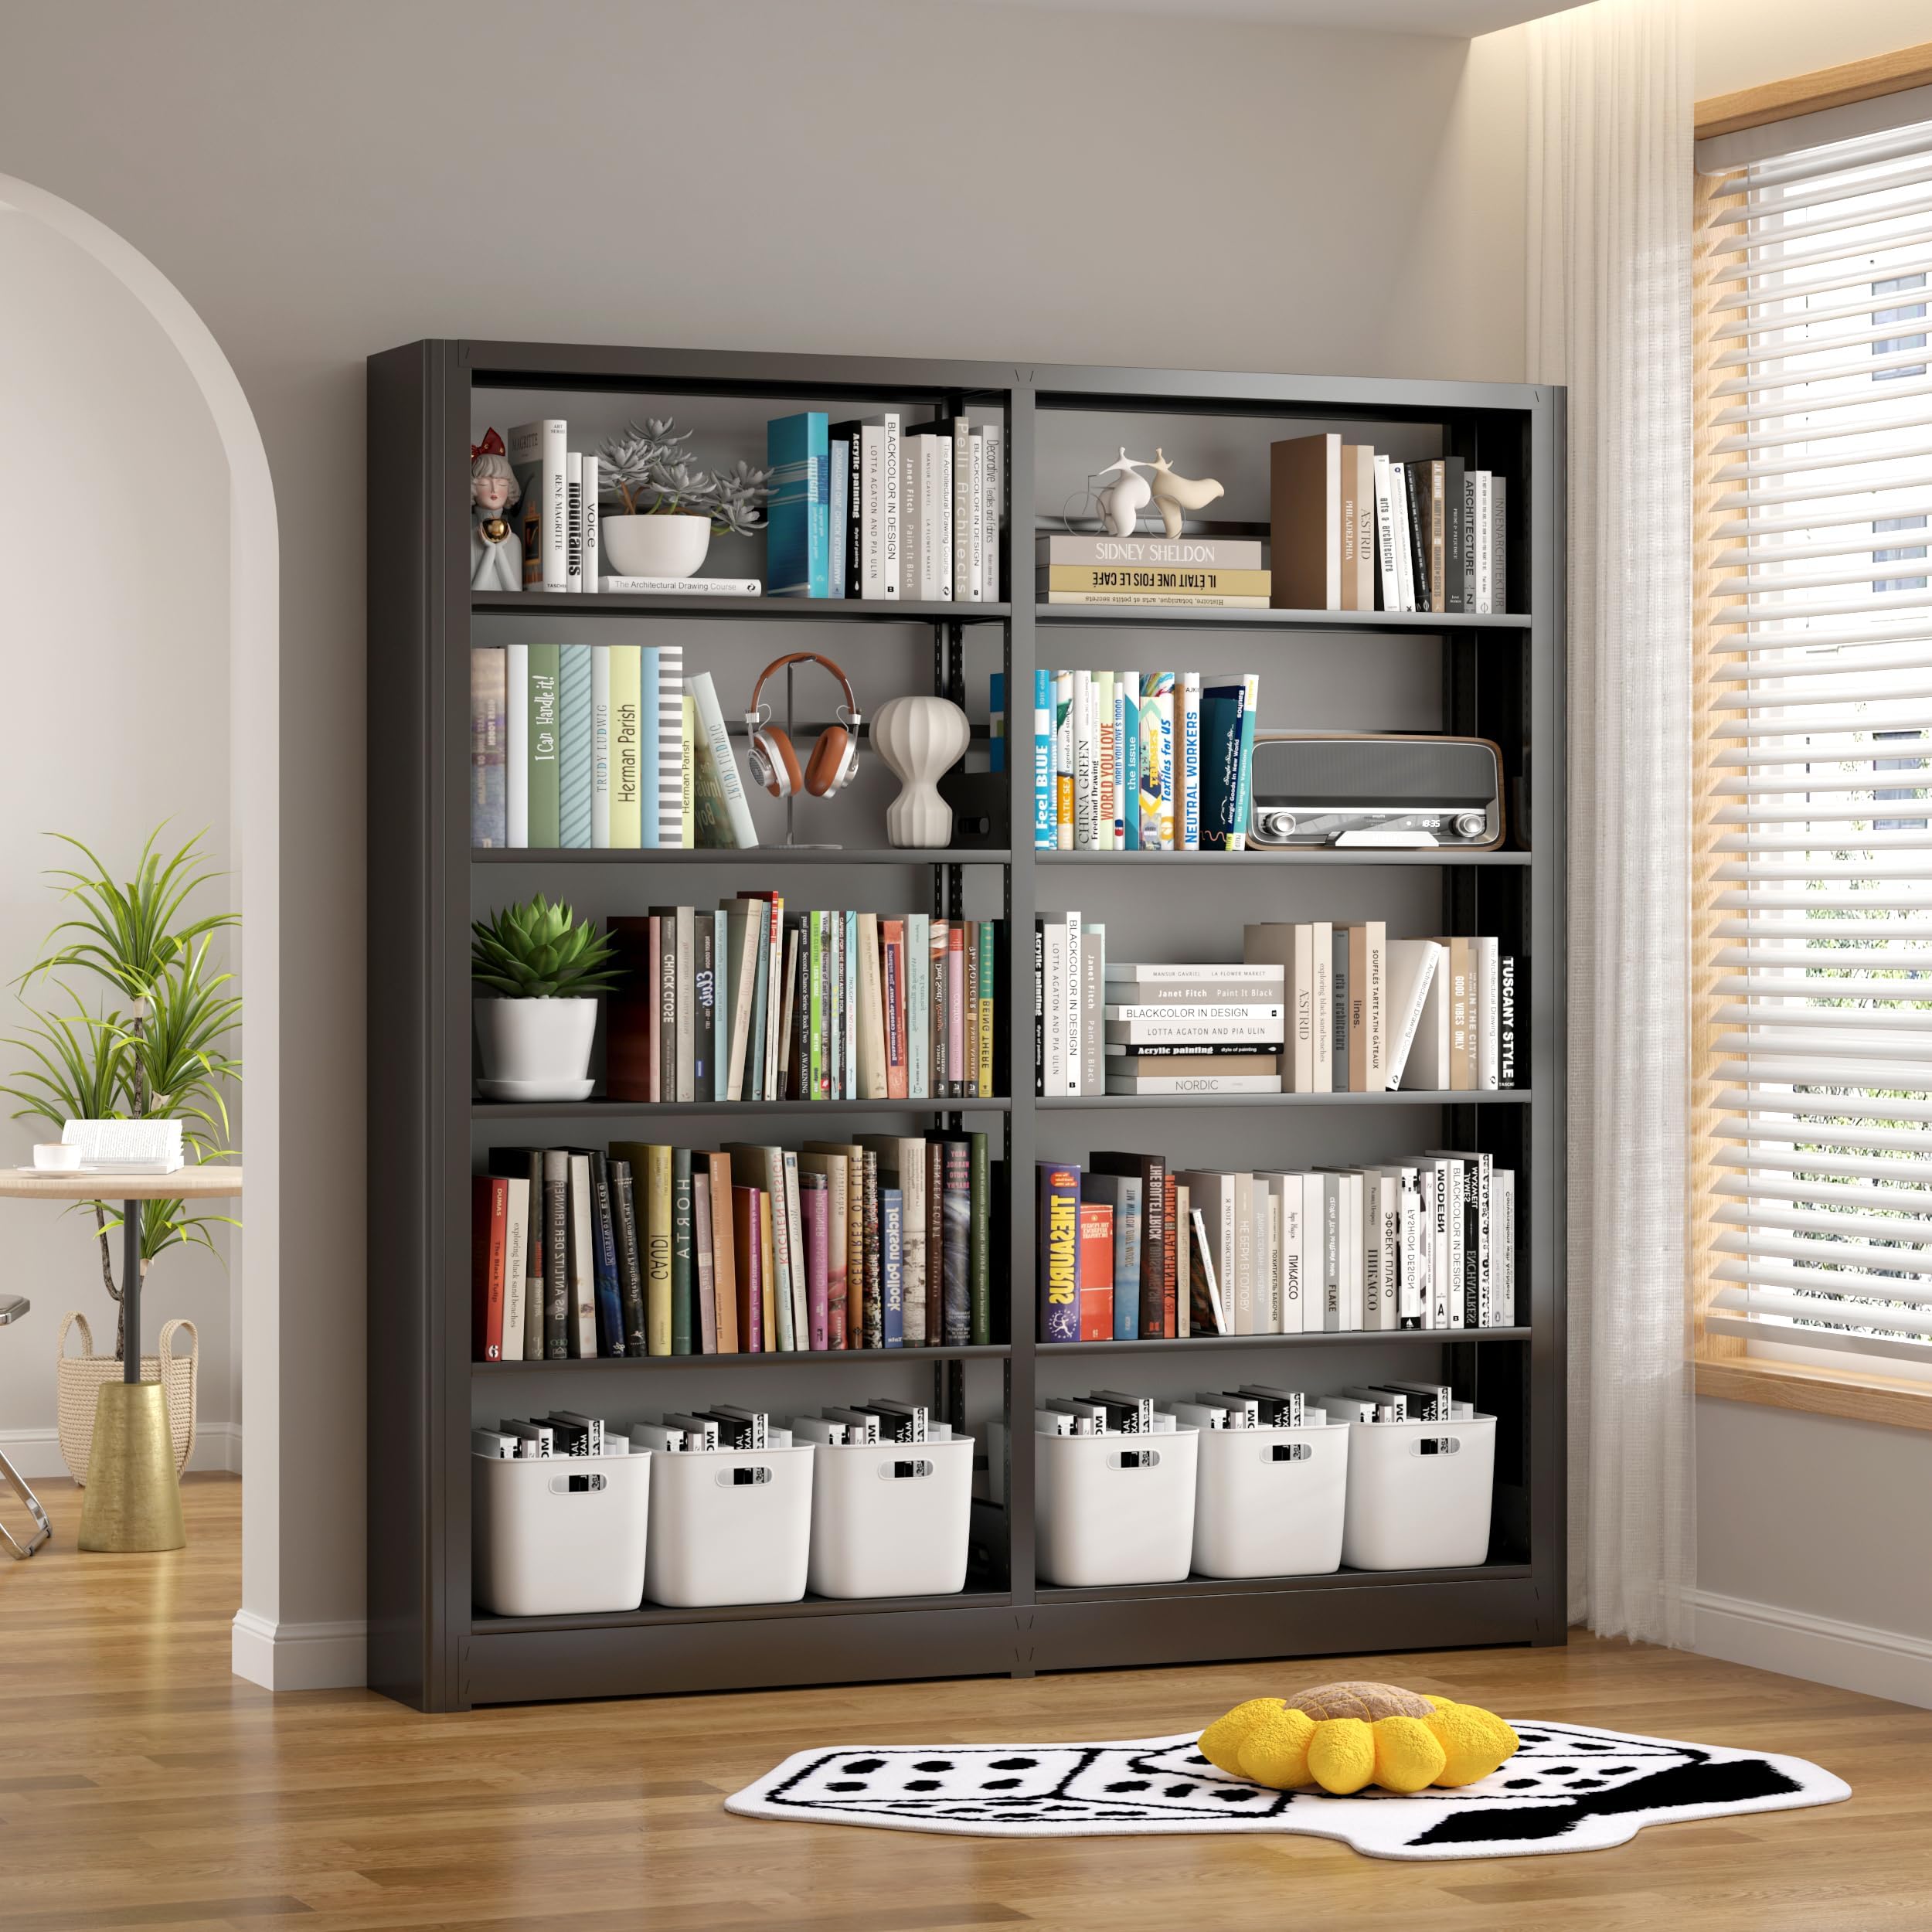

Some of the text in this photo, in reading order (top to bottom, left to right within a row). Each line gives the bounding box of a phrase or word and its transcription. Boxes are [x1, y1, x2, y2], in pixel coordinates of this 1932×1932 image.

[554, 474, 563, 551] RENÉ MAGRITTE
[887, 422, 896, 560] BLACKCOLOR IN DESIGN
[957, 423, 968, 594] Pelli Architects
[1379, 498, 1388, 512] arts
[568, 482, 582, 576] mountains
[587, 502, 595, 548] voice
[1360, 509, 1372, 560] ÆSTRID
[1383, 526, 1393, 573] architecture
[1465, 480, 1474, 576] ARCHITECTURE
[1096, 543, 1215, 563] SIDNEY SHELDON
[1495, 497, 1505, 607] INNENARCHITEKTUR
[631, 581, 676, 590] Architectural
[678, 583, 708, 591] Drawing
[710, 583, 736, 591] Course
[1093, 572, 1216, 590] IL ÉTAIT UNE FOIS LE CAFÉ
[1158, 597, 1193, 605] botanique,
[1194, 597, 1223, 606] Histoire,
[532, 675, 555, 691] it!
[533, 692, 554, 725] Handle
[536, 732, 555, 753] Can
[597, 705, 607, 792] TRUDY LUDWIG
[618, 703, 635, 802] Herman Parish
[1128, 736, 1137, 791] the issue
[1161, 738, 1172, 756] for
[682, 740, 690, 814] Herman Parish
[1036, 745, 1049, 829] Feel BLUE
[1079, 740, 1089, 844] CHINA GREEN
[1100, 723, 1114, 821] WORLD YOU LOVE
[1161, 759, 1172, 802] Textiles
[1185, 712, 1198, 844] NEUTRAL WORKERS
[1126, 1008, 1249, 1018] BLACKCOLOR IN DESIGN
[1251, 988, 1273, 997] Black
[1299, 989, 1310, 1040] ÆSTRID
[1353, 1000, 1362, 1029] lines.
[1455, 975, 1464, 1050] GOOD VIBES ONLY
[1502, 957, 1514, 1079] TUSCANY STYLE
[1138, 1046, 1214, 1056] Acrylic painting
[1175, 1080, 1219, 1091] NORDIC
[1385, 1212, 1393, 1298] ЭФФЕКТ ПЛАТО
[1453, 1240, 1461, 1250] IN
[510, 1223, 521, 1328] exploring black sand beaches
[1288, 1255, 1298, 1300] ПИКАССО
[1368, 1249, 1379, 1311] ПИКАССО
